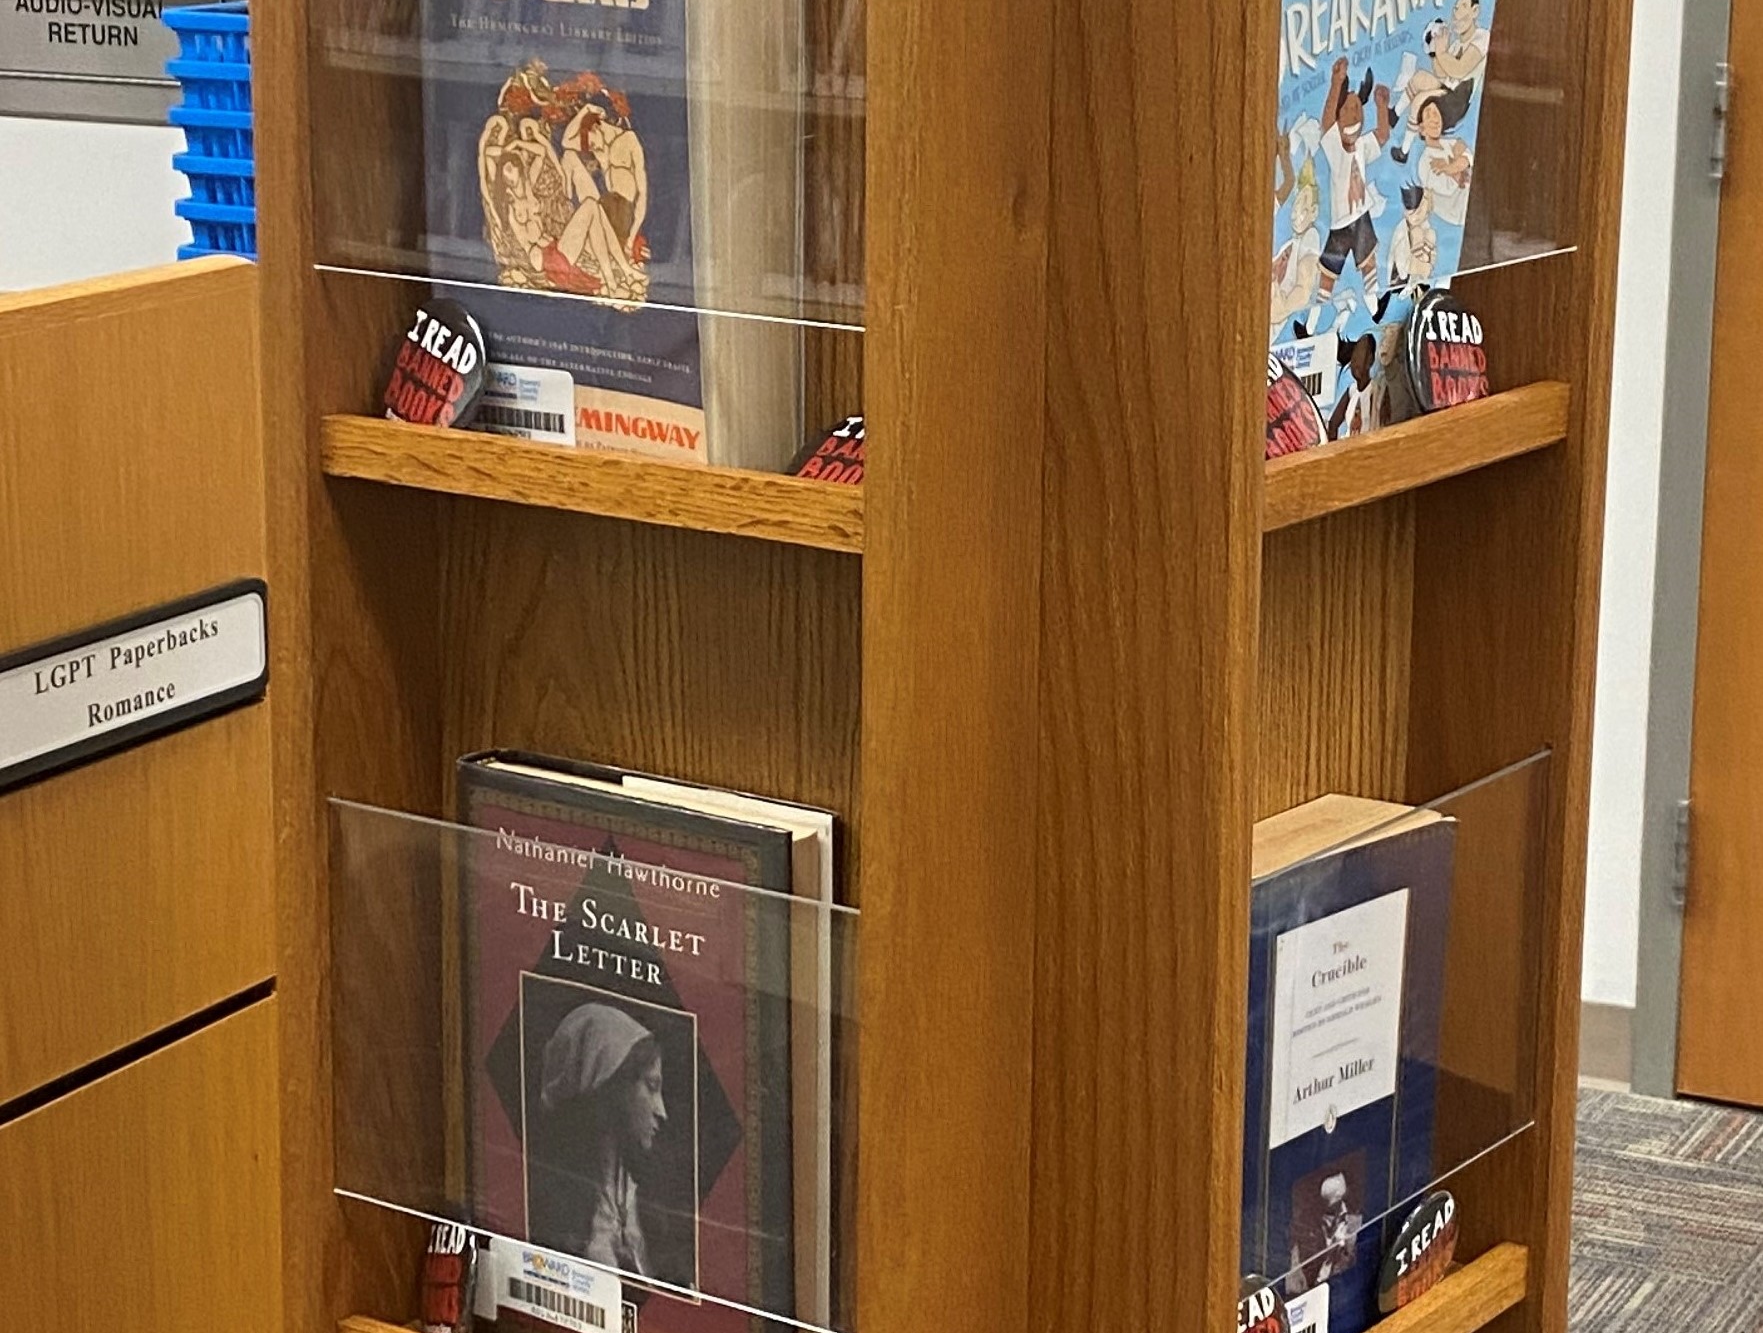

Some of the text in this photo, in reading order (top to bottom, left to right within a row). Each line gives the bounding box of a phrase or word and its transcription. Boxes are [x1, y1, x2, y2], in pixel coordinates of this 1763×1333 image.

[48, 22, 138, 46] RETURN
[407, 309, 477, 374] I READ
[1422, 309, 1483, 345] I READ
[397, 340, 464, 403] BANNED
[1428, 341, 1487, 373] BANNED
[384, 368, 455, 428] BOOKS
[575, 406, 700, 450] MINGWAY
[34, 619, 219, 695] LGPT Paperbacks
[87, 682, 176, 728] Romance
[497, 826, 721, 899] Nathaniel Hawthorne
[510, 882, 706, 956] THE SCARLET
[552, 930, 662, 985] LETTER
[1311, 955, 1368, 988] Crucible
[1293, 1057, 1376, 1105] Arthur Miller
[1396, 1248, 1409, 1276] I
[1411, 1198, 1455, 1262] READ
